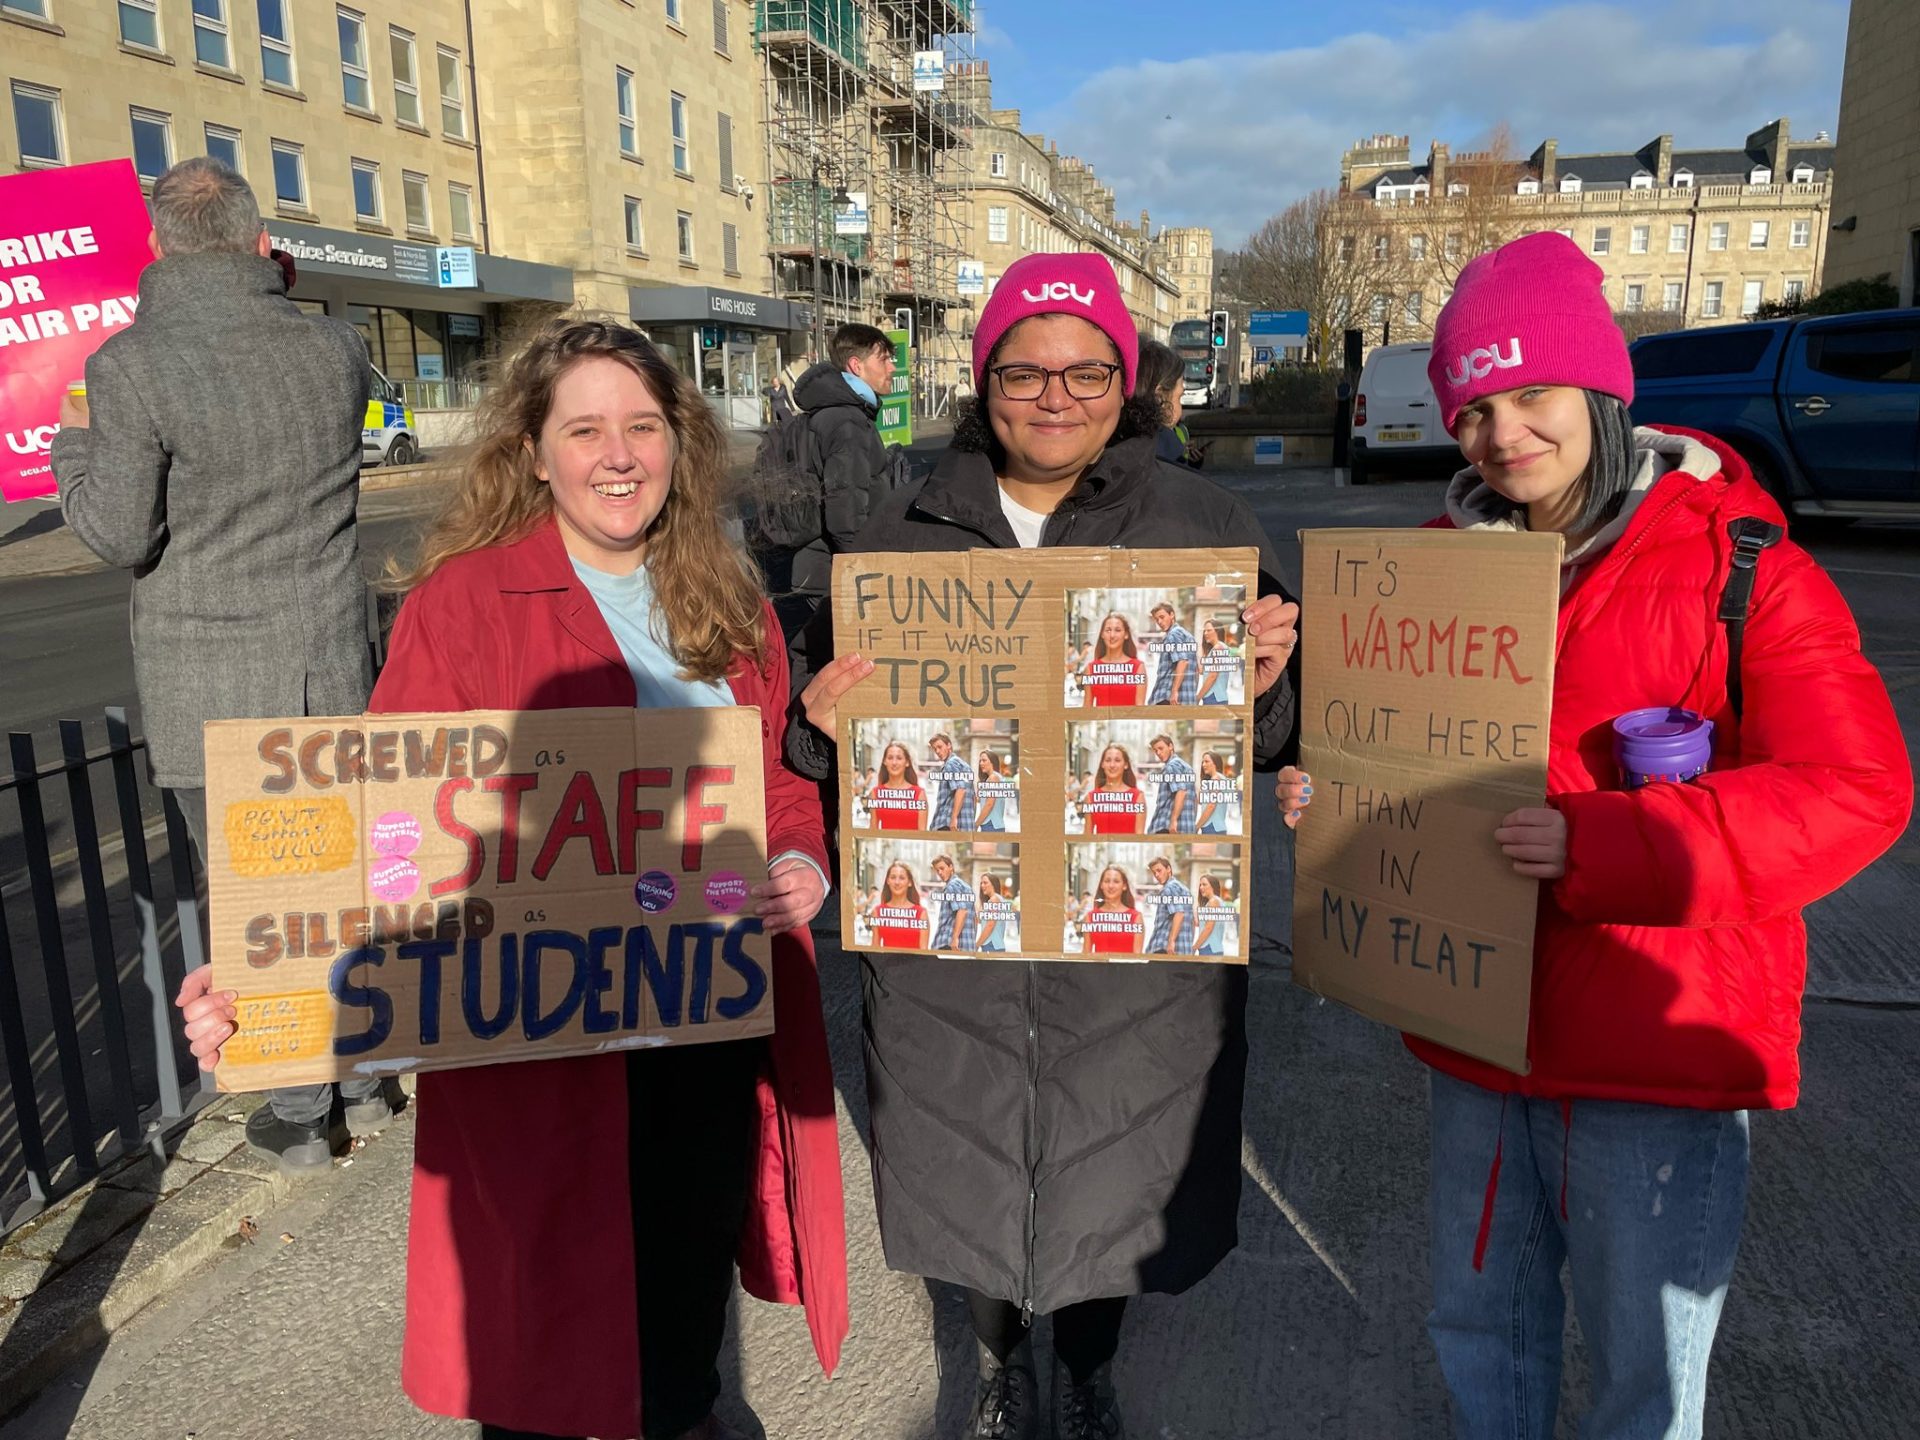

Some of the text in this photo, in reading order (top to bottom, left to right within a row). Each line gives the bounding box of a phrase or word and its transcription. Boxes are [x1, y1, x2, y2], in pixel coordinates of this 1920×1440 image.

[325, 244, 388, 270] Services
[1022, 281, 1095, 307] UCU
[712, 296, 756, 316] LEWIS HOUSE
[0, 309, 70, 347] AIR
[1445, 337, 1523, 386] UCU
[883, 407, 900, 426] NOW
[5, 423, 60, 455] UC
[1334, 547, 1398, 598] IT'S
[854, 572, 1033, 631] FUNNY
[858, 628, 883, 650] IF
[902, 630, 928, 651] IT
[1342, 603, 1533, 685] WARMER
[1150, 642, 1197, 652] UNI OF BATH
[1093, 663, 1134, 674] LITERALLY
[873, 657, 1017, 710] TRUE
[1082, 674, 1146, 685] ANYTHING ELSE
[1325, 700, 1538, 762] OUT HERE
[258, 724, 566, 793] SCREWED as
[929, 772, 975, 781] UNI OF BATH
[1149, 774, 1195, 783] UNI OF BATH
[978, 782, 1015, 790] PERMANENT
[1201, 779, 1237, 791] STABLE
[877, 789, 916, 799] LITERALLY
[978, 790, 1016, 798] CONTRACTS
[1093, 792, 1134, 802] LITERALLY
[1200, 792, 1238, 803] INCOME
[867, 800, 927, 810] ANYTHING ELSE
[1082, 803, 1145, 813] ANYTHING ELSE
[1331, 781, 1423, 832] THAN
[376, 821, 417, 831] SUPPORT
[428, 765, 736, 899] STAFF
[374, 829, 421, 839] THE STRIKE
[373, 861, 411, 880] SUPPORT
[1380, 849, 1420, 896] IN
[373, 869, 419, 888] THE STRIKE
[708, 879, 744, 889] SUPPORT
[637, 881, 674, 900] BREAKING
[706, 887, 746, 897] THE STRIKE
[931, 892, 975, 902] UNI OF BATH
[1147, 895, 1193, 905] UNI OF BATH
[879, 908, 918, 918] LITERALLY
[983, 903, 1012, 911] DECENT
[979, 912, 1016, 921] PENSIONS
[1092, 912, 1132, 923] LITERALLY
[869, 918, 928, 930] ANYTHING ELSE
[1081, 923, 1143, 933] ANYTHING ELSE
[245, 897, 546, 969] SILENCED as
[1323, 887, 1496, 989] MY FLAT
[328, 917, 768, 1056] STUDENTS
